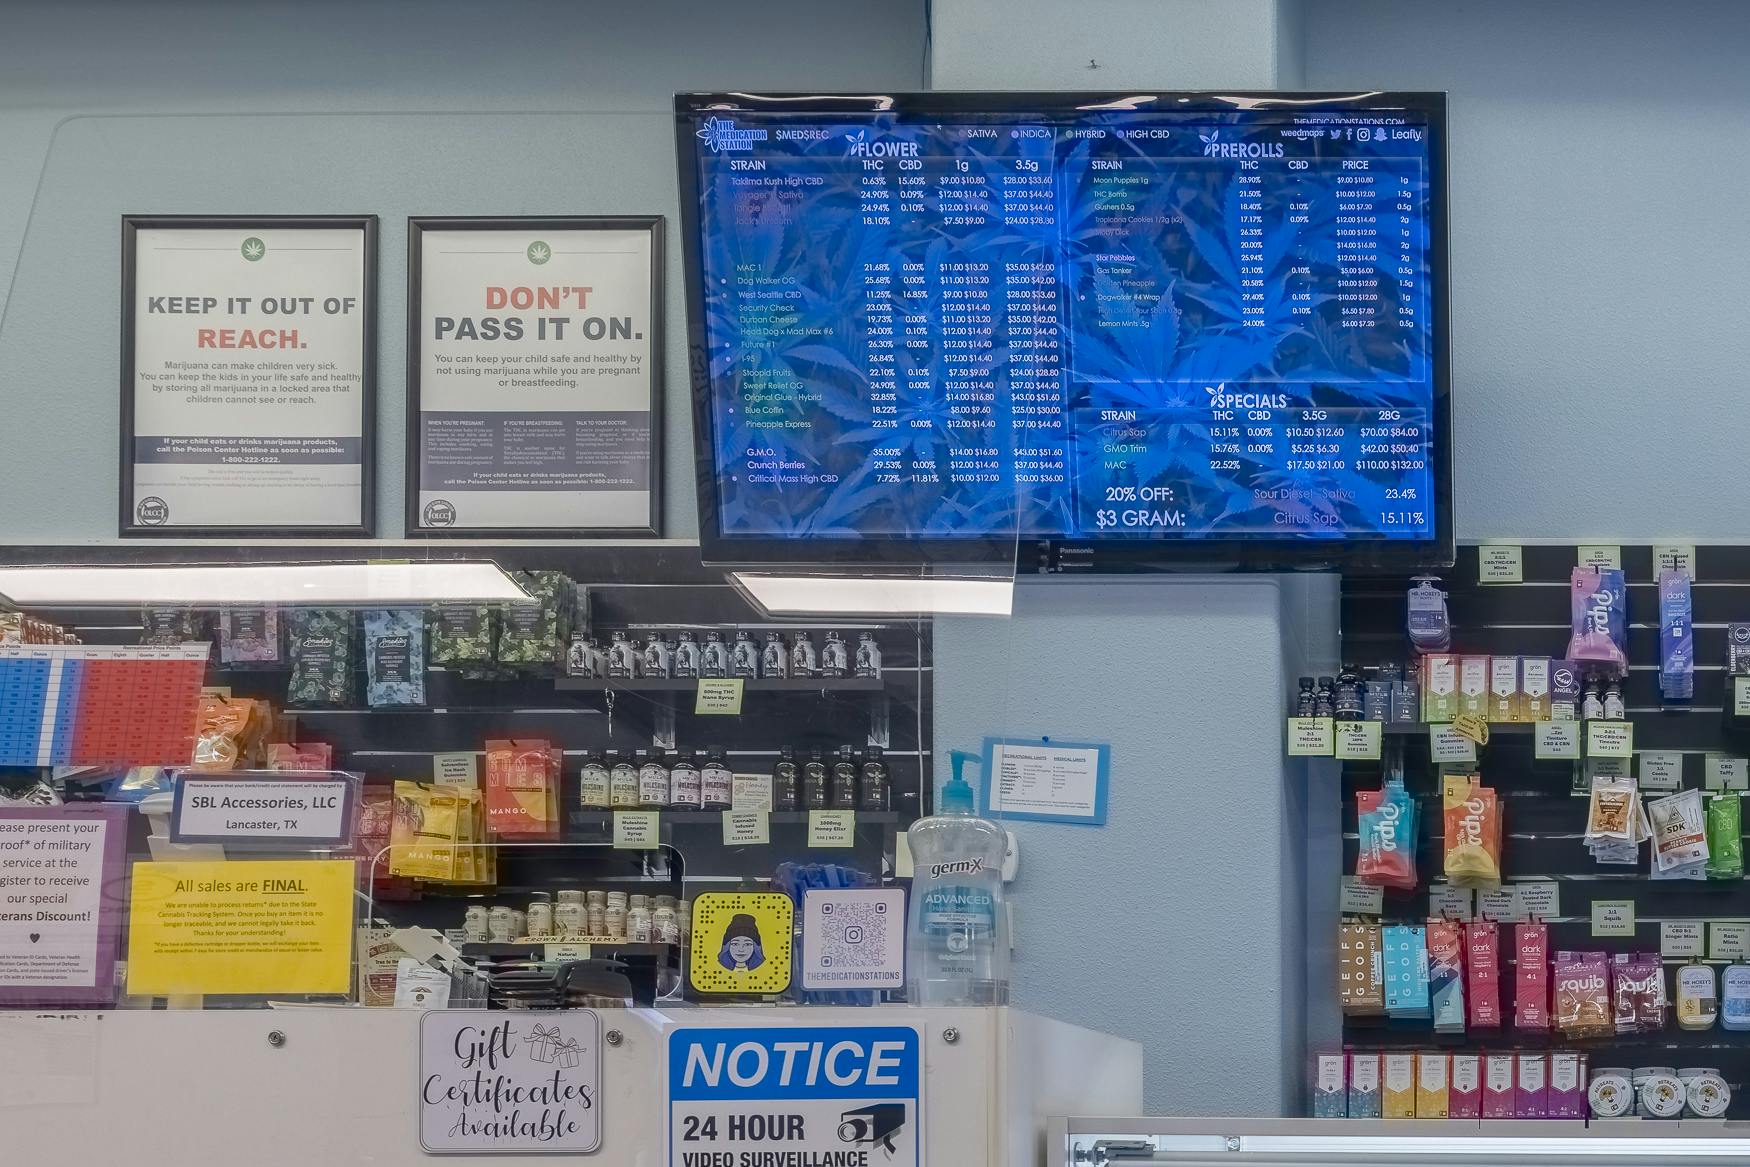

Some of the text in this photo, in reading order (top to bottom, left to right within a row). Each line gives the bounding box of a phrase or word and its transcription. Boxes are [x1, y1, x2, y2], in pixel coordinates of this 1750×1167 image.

[718, 121, 734, 130] THE
[719, 130, 767, 141] MEDICATION
[776, 129, 829, 141] $MED$REC
[967, 129, 998, 138] SATIVA
[1020, 129, 1051, 138] INDICA
[1075, 129, 1106, 139] HYBRID
[1126, 129, 1169, 139] HIGH CBD
[1281, 129, 1324, 139] weedmaps
[720, 141, 752, 150] STATION
[858, 143, 918, 157] FLOWER
[1212, 143, 1283, 158] PREROLLS
[731, 160, 1038, 172] STRAIN THC CBD 1g 3.5g
[485, 286, 593, 310] DON'T
[148, 296, 356, 315] KEEP IT OUT OF
[434, 317, 643, 340] PASS IT ON.
[197, 329, 308, 349] REACH.
[165, 361, 208, 371] Marijuana
[230, 362, 255, 370] make
[257, 362, 293, 370] children
[296, 364, 315, 372] very
[318, 362, 338, 370] sick.
[454, 366, 481, 377] using
[484, 366, 531, 376] marijuana
[533, 366, 558, 375] while
[560, 368, 578, 377] you
[598, 367, 640, 376] pregnant
[498, 377, 579, 389] or breastfeeding.
[1217, 394, 1287, 409] SPECIALS
[1104, 460, 1424, 470] MAC 22.52% $17.50 $21.00 $110.00 $132.00
[748, 474, 939, 484] Critical Mass High CBD 7.72% 11.81%
[1106, 487, 1416, 502] 20% OFF: 23.4%
[1096, 509, 1424, 529] $3 GRAM: Citrus Sap 15.11%
[192, 797, 336, 810] SBL Accessories, LLC
[28, 823, 70, 834] present
[74, 825, 99, 834] your
[226, 820, 297, 830] Lancaster, TX
[3, 858, 77, 868] service at the
[175, 880, 308, 894] All sales are FINAL.
[925, 894, 990, 904] ADVANCED
[37, 912, 91, 921] Discount!
[1356, 927, 1365, 996] GOODS
[1341, 942, 1350, 996] LEIF
[806, 970, 900, 981] THEMEDICATIONSTATIONS
[1559, 975, 1605, 993] squib
[454, 1020, 518, 1075] Gift
[682, 1040, 906, 1088] NOTICE
[423, 1070, 595, 1114] Certificates
[448, 1110, 582, 1141] Available
[683, 1114, 805, 1142] 24 HOUR
[740, 1150, 869, 1167] SURVEILLANCE
